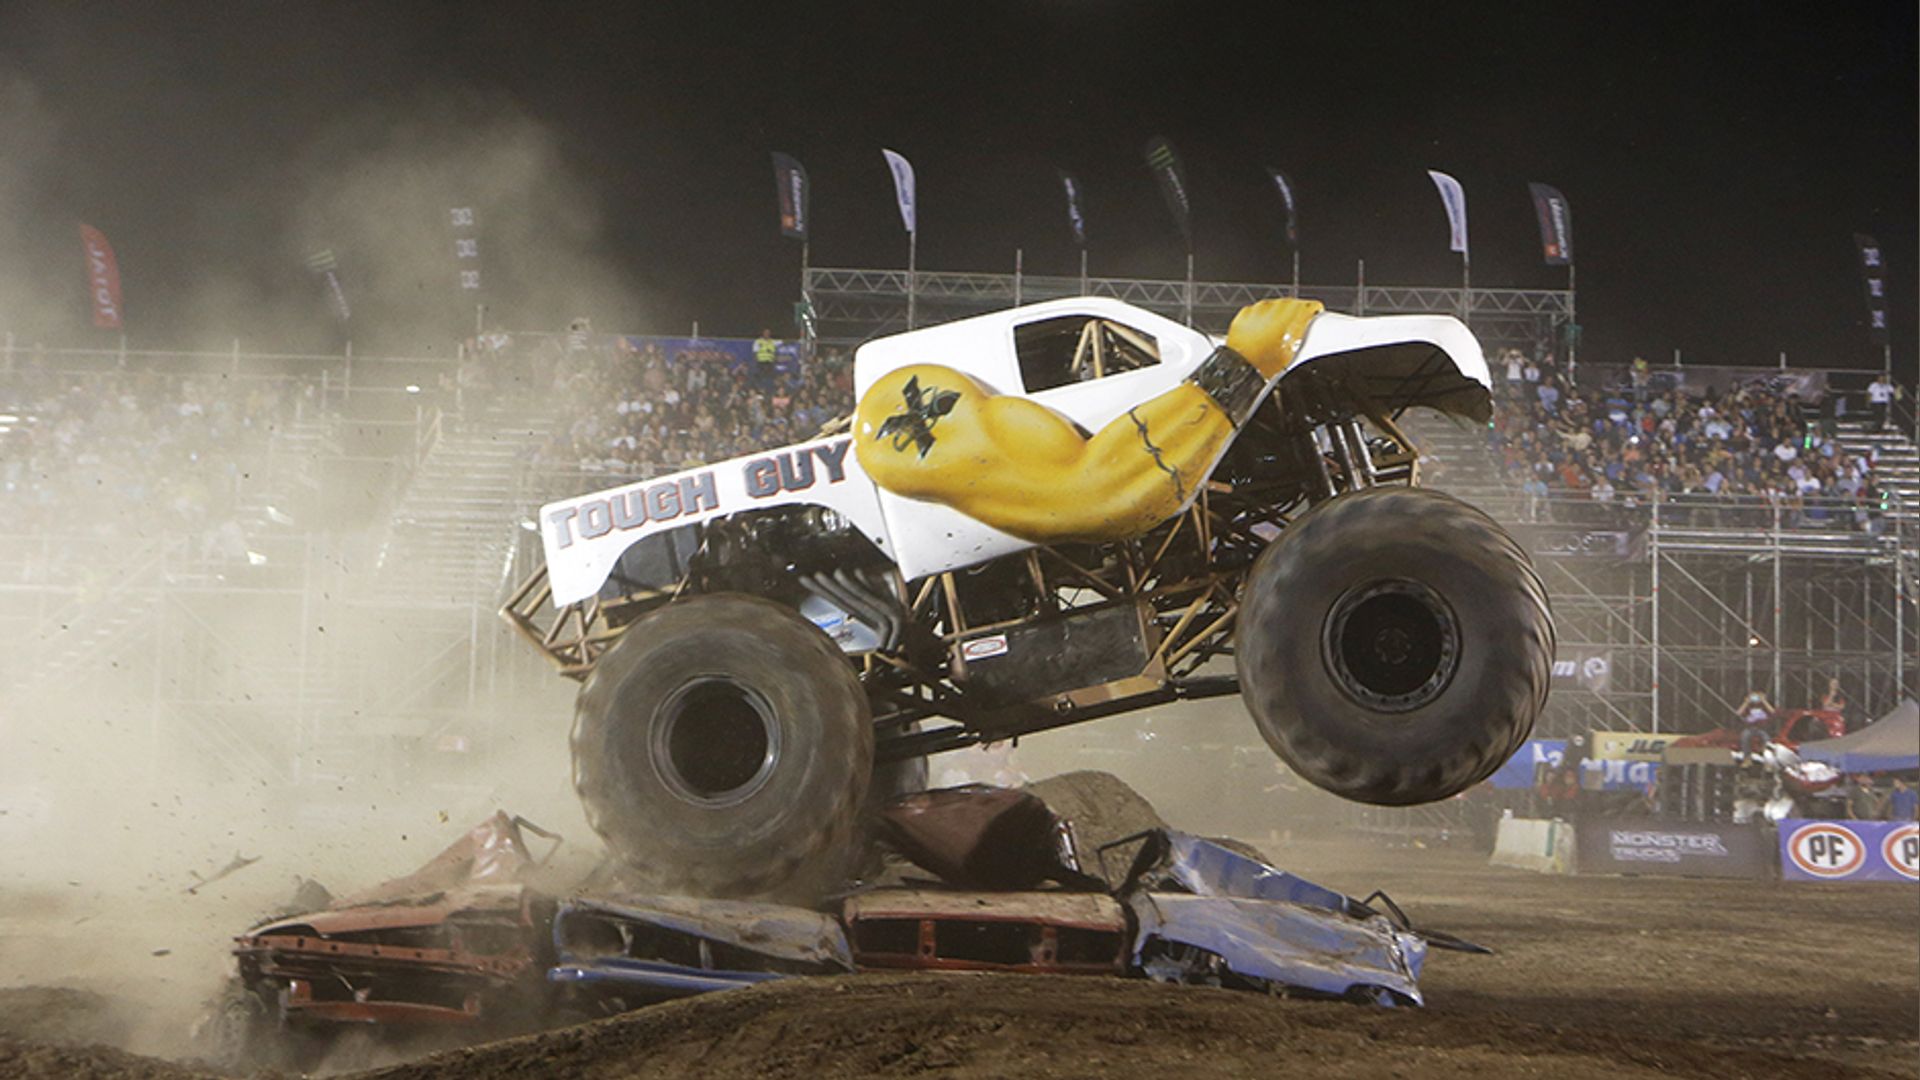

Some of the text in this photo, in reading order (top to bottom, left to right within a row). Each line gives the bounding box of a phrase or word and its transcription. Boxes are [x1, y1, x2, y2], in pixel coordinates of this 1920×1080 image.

[551, 438, 853, 549] TOUGH GUY
[1627, 739, 1667, 753] JLG
[1808, 834, 1844, 865] PF
[1902, 837, 1919, 866] P
